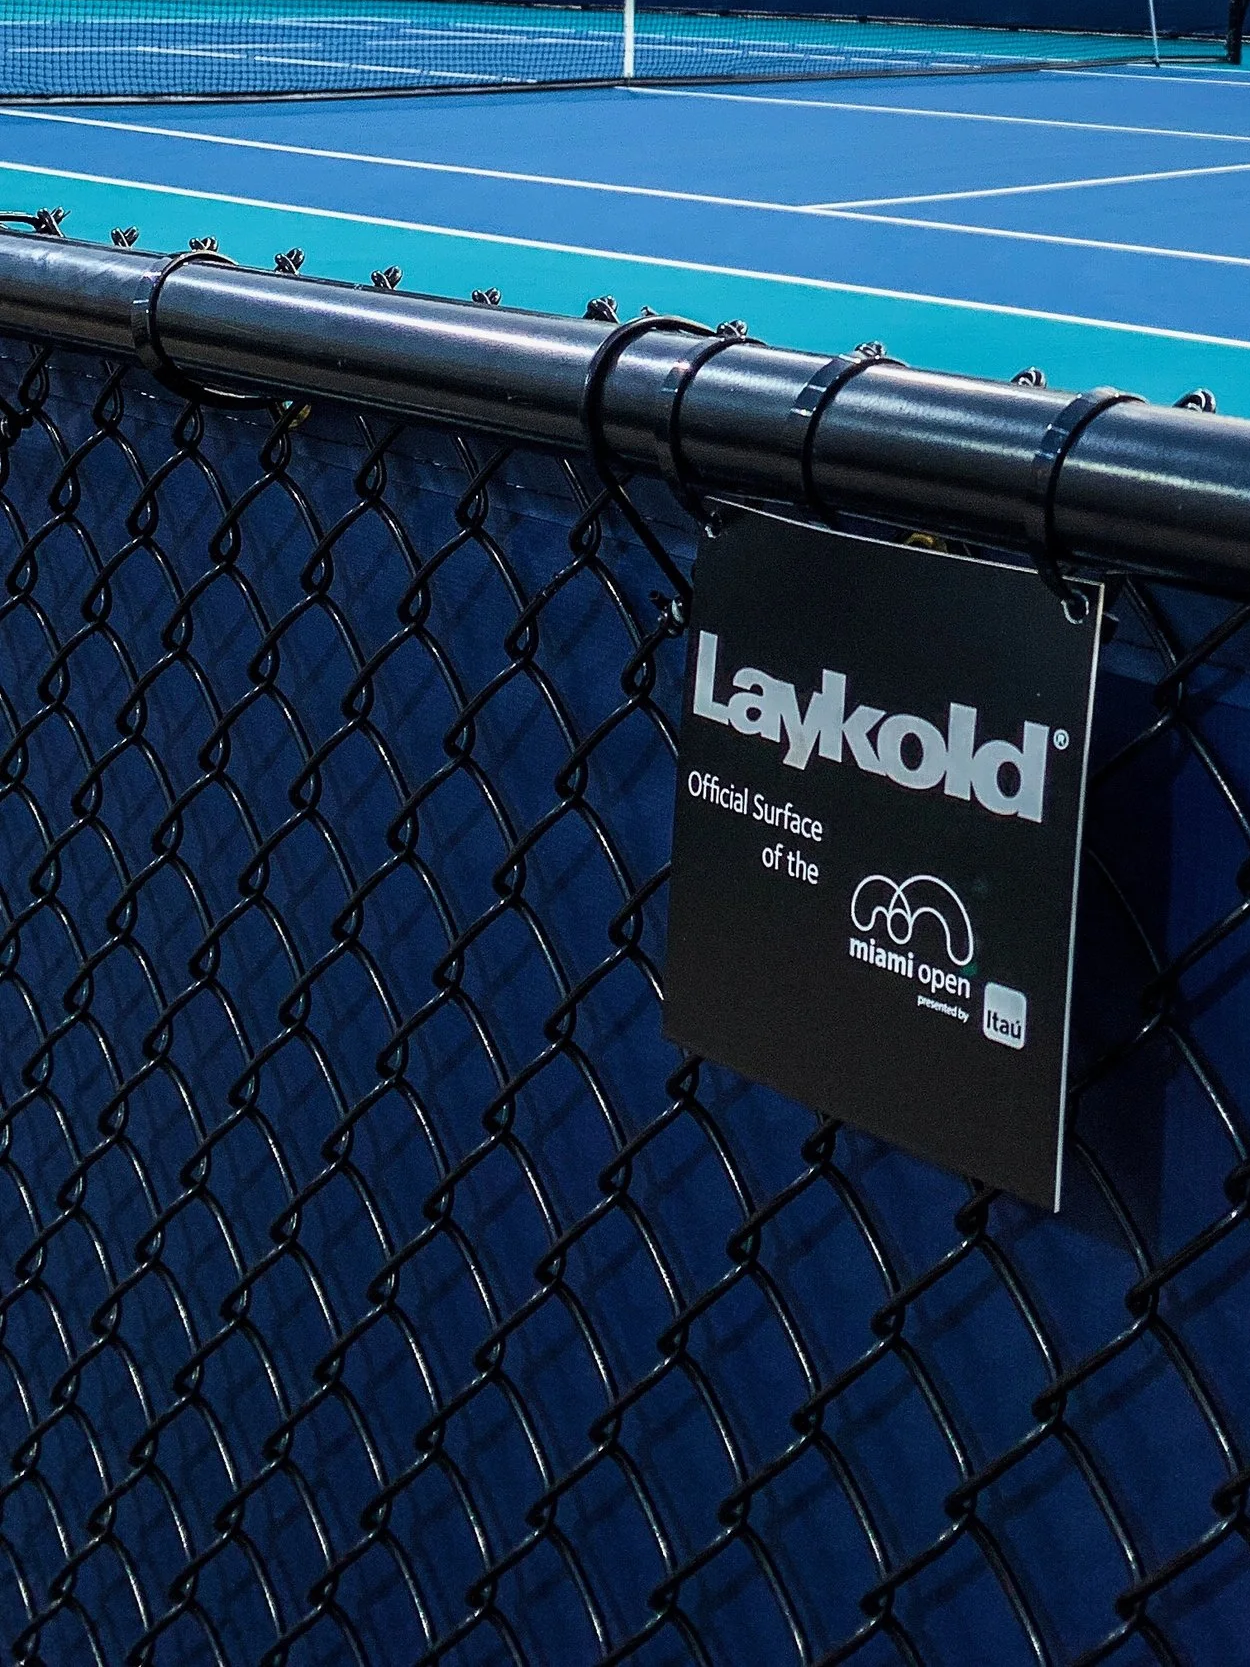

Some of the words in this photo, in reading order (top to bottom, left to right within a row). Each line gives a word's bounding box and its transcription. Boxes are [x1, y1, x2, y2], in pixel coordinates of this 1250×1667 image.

[687, 770, 749, 815] Official
[752, 793, 823, 842] Surface
[761, 842, 784, 870] of
[787, 850, 819, 885] the
[849, 936, 914, 979] miami
[917, 963, 971, 999] open
[917, 994, 957, 1018] presented
[957, 1007, 970, 1024] by
[986, 1009, 1023, 1040] Itaú
